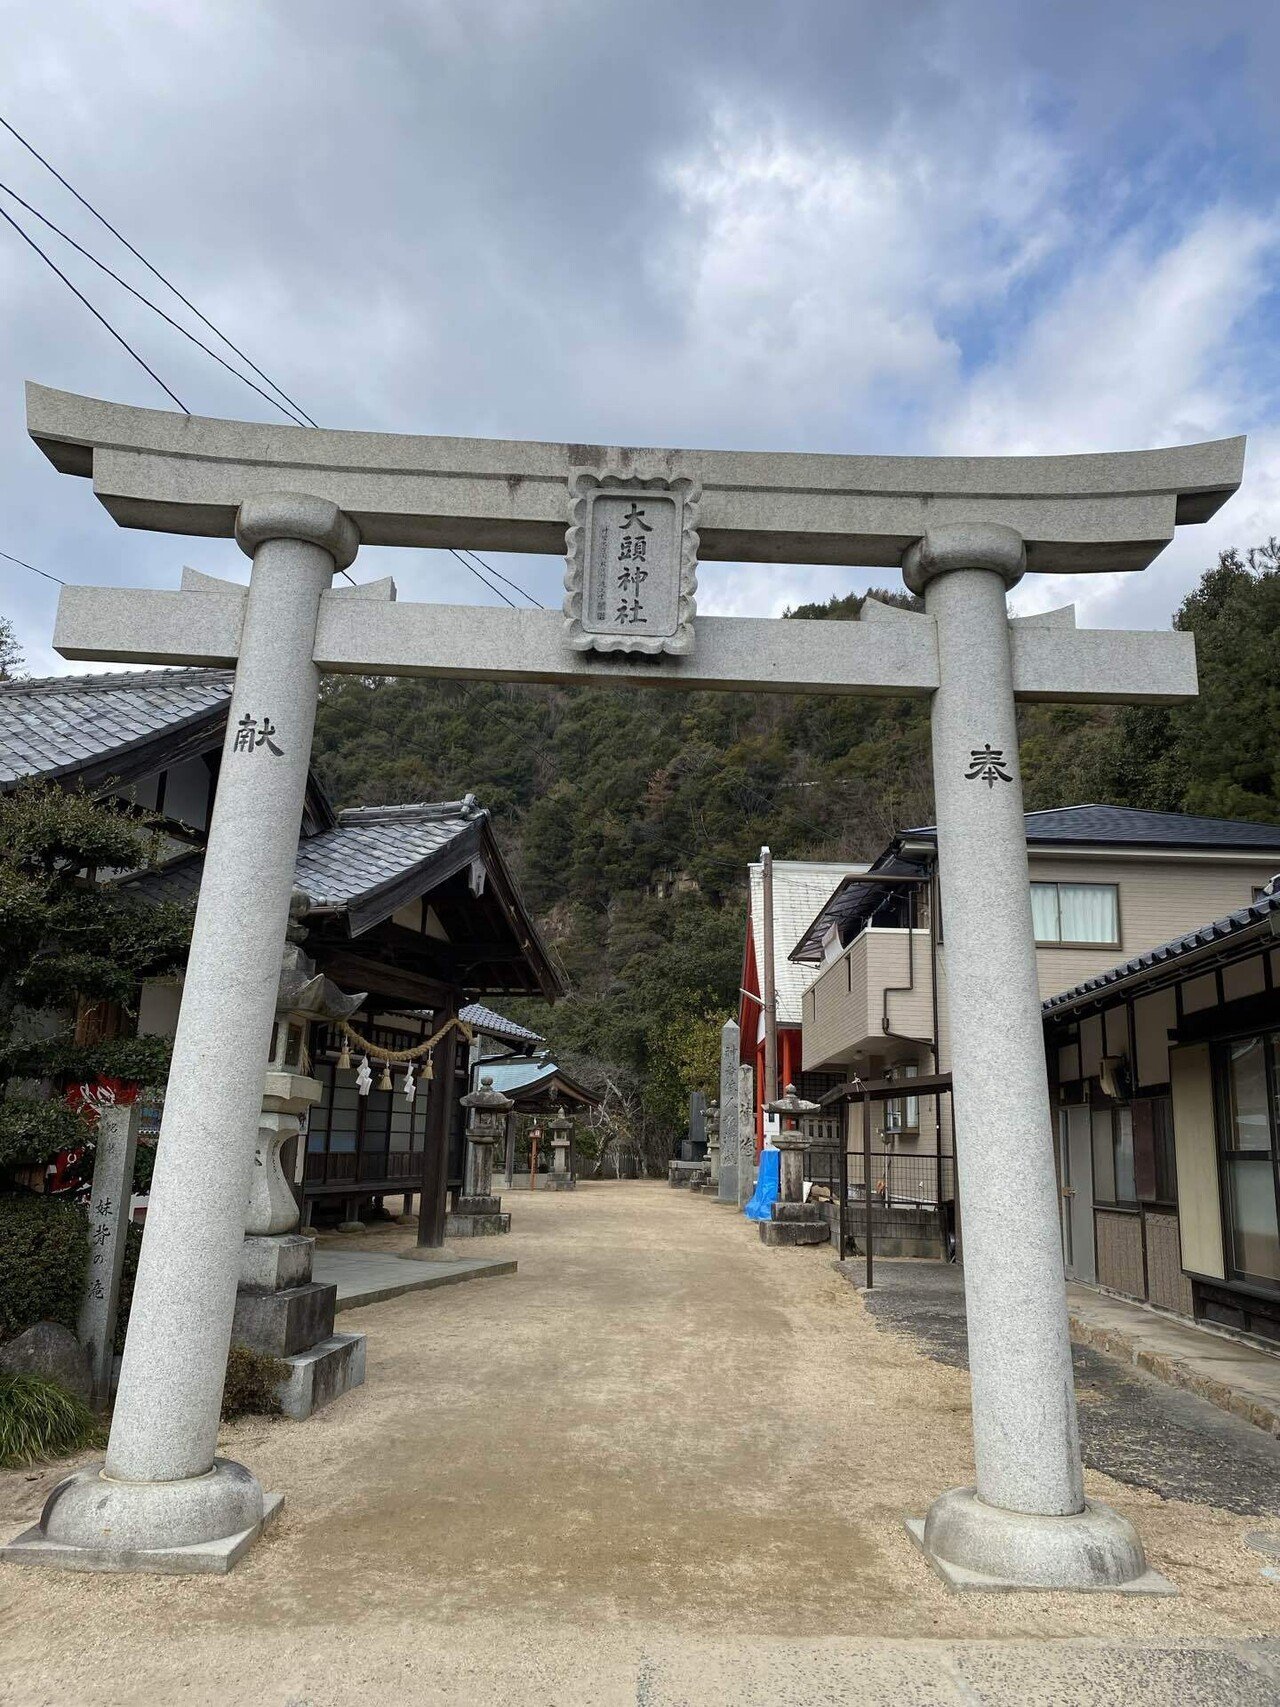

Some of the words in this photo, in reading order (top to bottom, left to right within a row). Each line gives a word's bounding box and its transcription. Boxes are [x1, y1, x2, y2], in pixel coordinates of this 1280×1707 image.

[614, 503, 653, 625] 大頭神社
[233, 712, 285, 757] 献
[964, 743, 1014, 789] 奉
